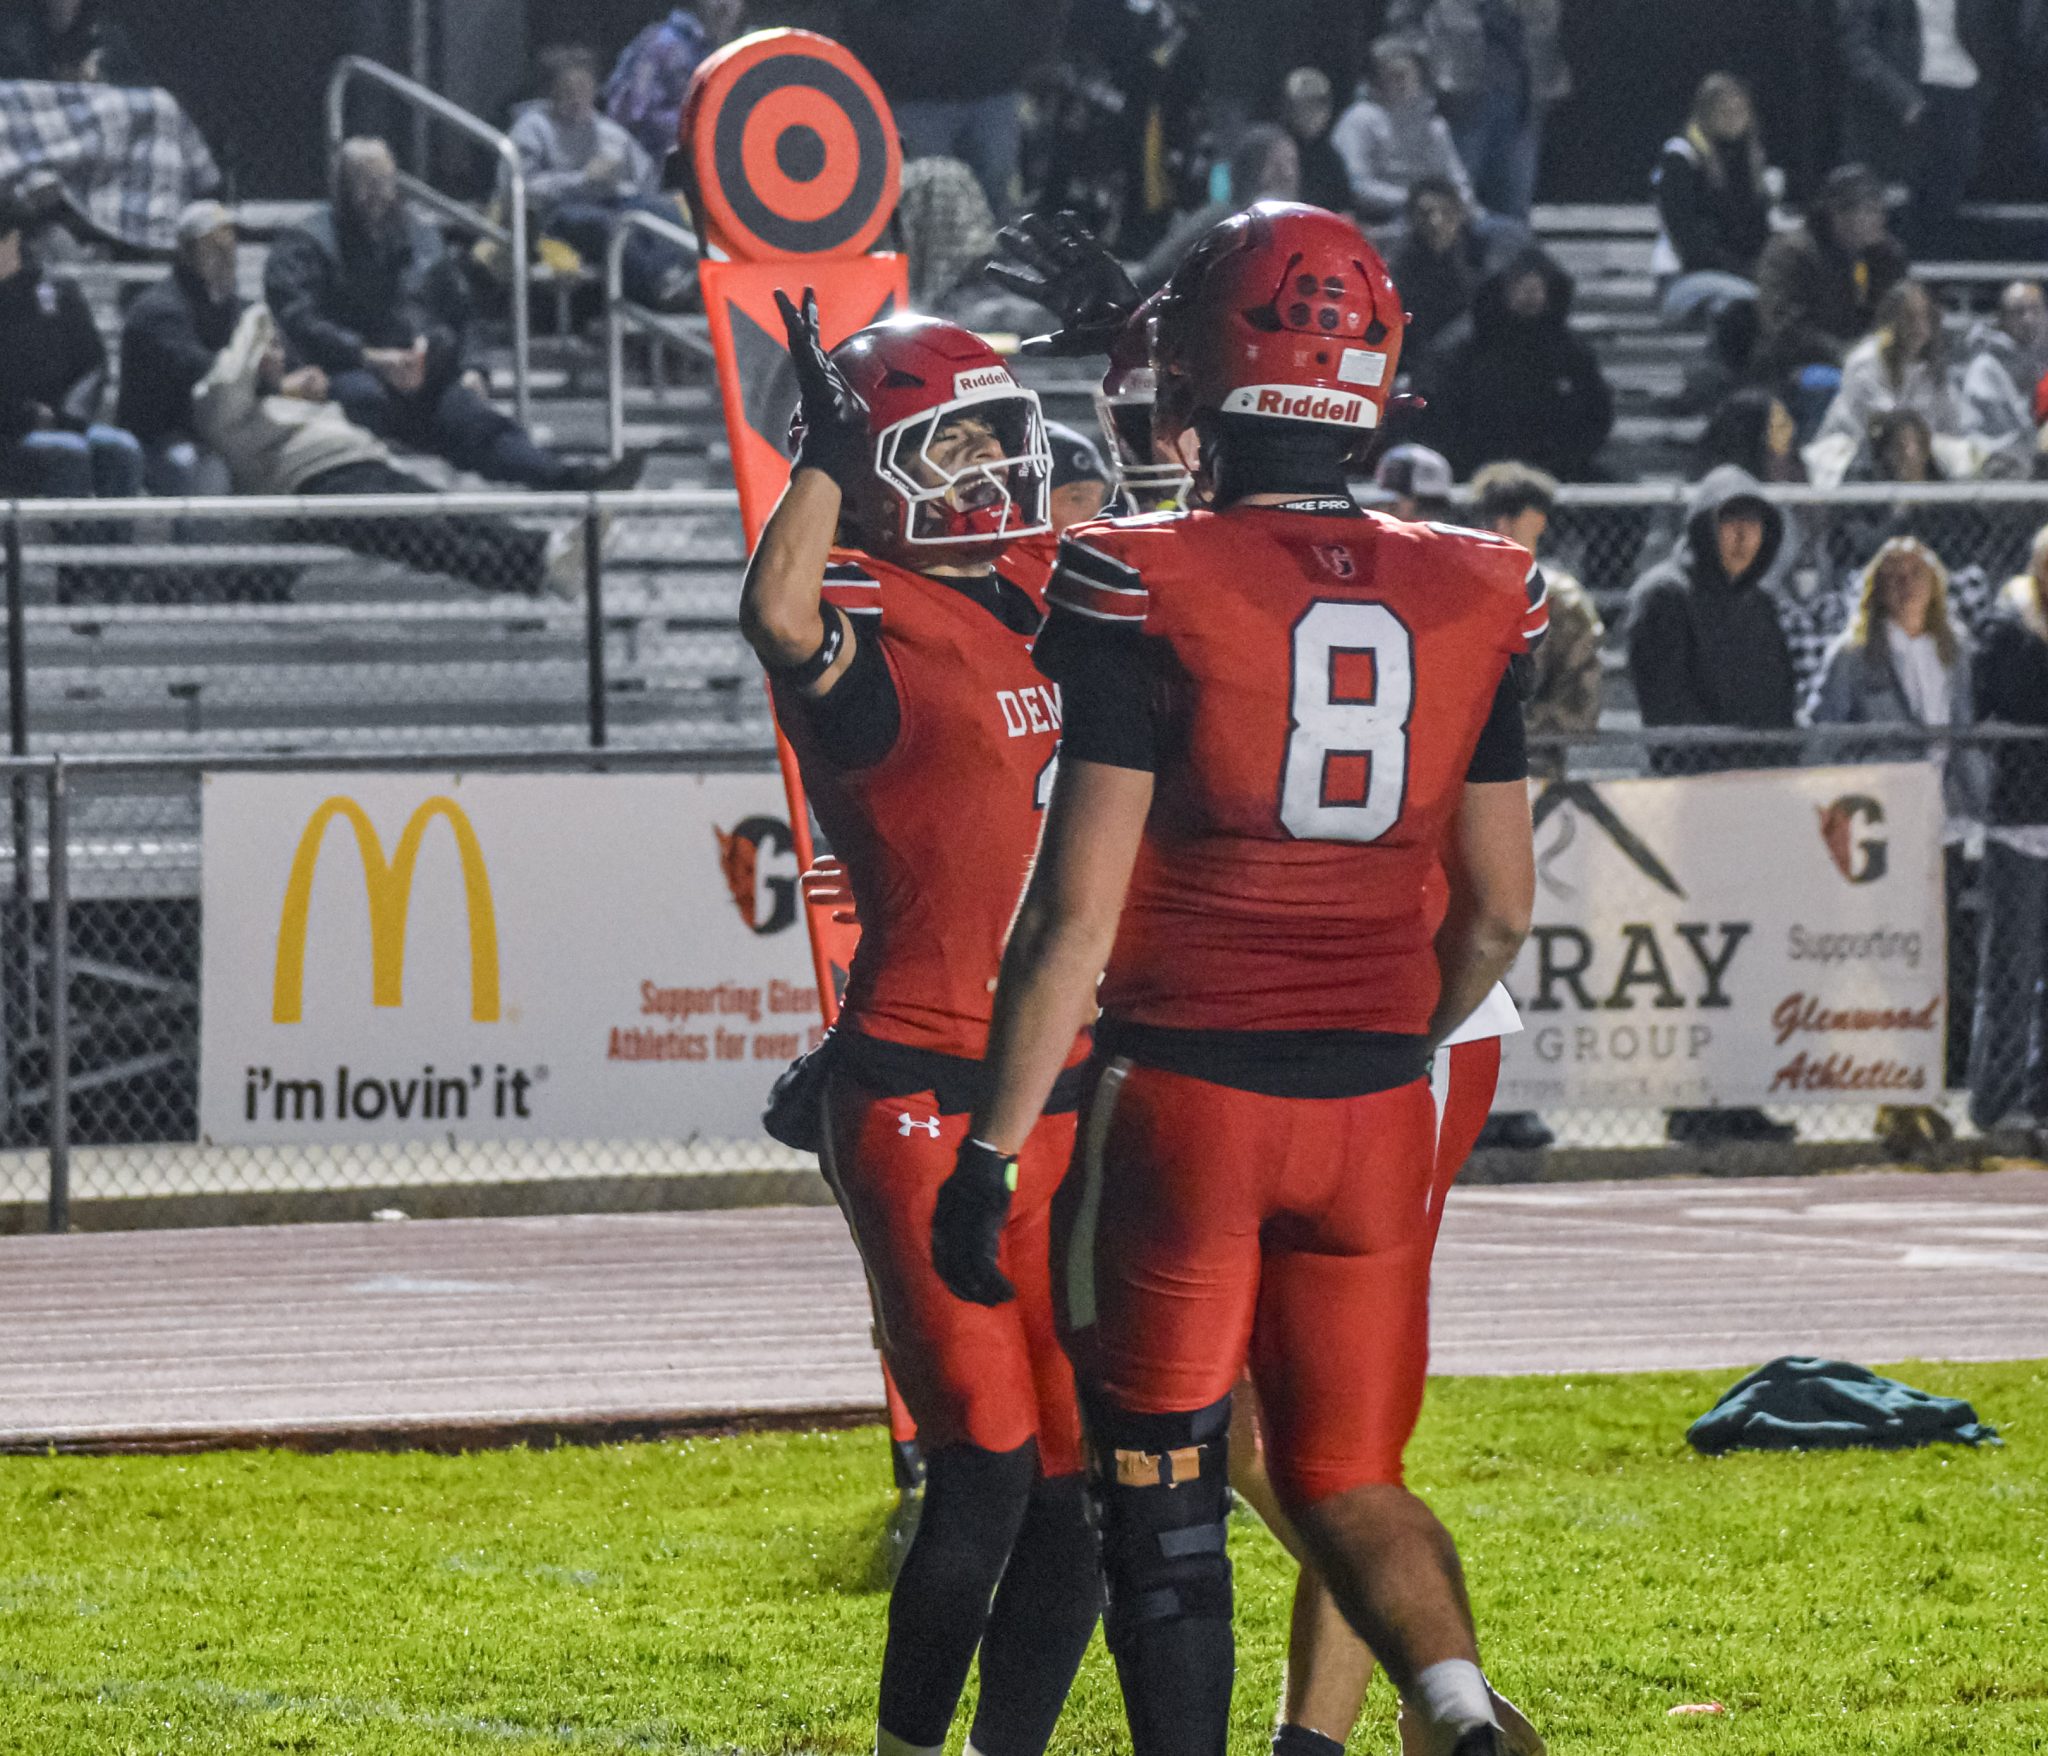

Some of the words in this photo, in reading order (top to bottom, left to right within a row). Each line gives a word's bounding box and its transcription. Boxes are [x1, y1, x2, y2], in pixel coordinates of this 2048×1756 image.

[959, 371, 1010, 392] Riddell
[1256, 389, 1363, 424] Riddell
[1318, 500, 1350, 511] PRO
[1277, 597, 1416, 842] 8
[1510, 921, 1752, 1011] RAY
[1787, 922, 1922, 969] Supporting
[640, 977, 762, 1024] Supporting
[1771, 991, 1941, 1046] Glenwood
[607, 1024, 708, 1061] Athletics
[714, 1025, 747, 1061] for
[753, 1032, 800, 1061] over
[1534, 1024, 1714, 1063] GROUP
[246, 1065, 324, 1121] i'm
[337, 1064, 482, 1121] lovin'
[1767, 1051, 1927, 1094] Athletics
